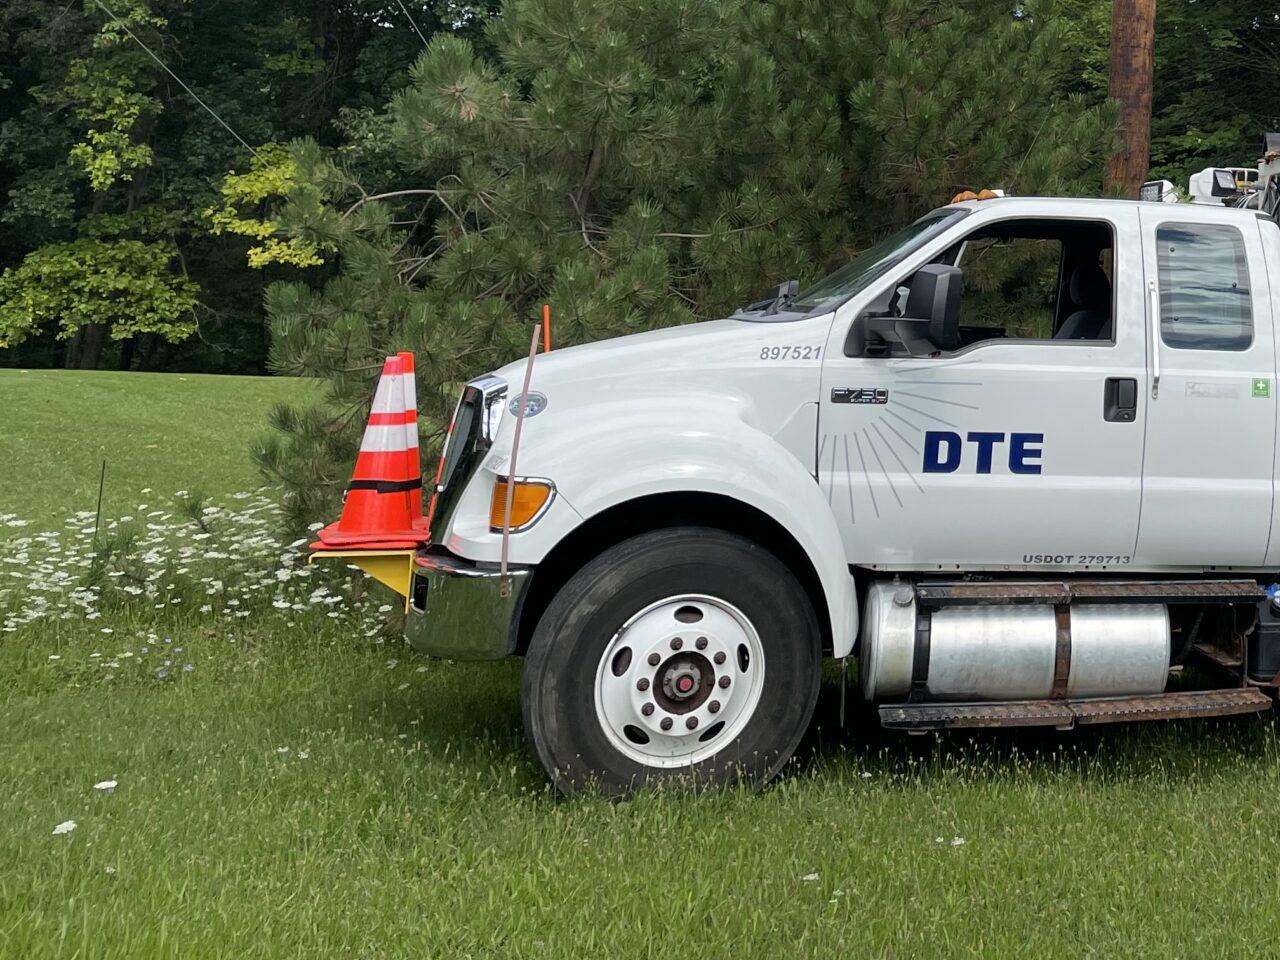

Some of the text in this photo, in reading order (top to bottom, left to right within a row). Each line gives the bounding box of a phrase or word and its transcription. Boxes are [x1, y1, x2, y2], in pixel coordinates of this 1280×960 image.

[760, 346, 822, 360] 897521
[922, 431, 1044, 475] DTE
[1023, 555, 1131, 564] USDOT 279713
